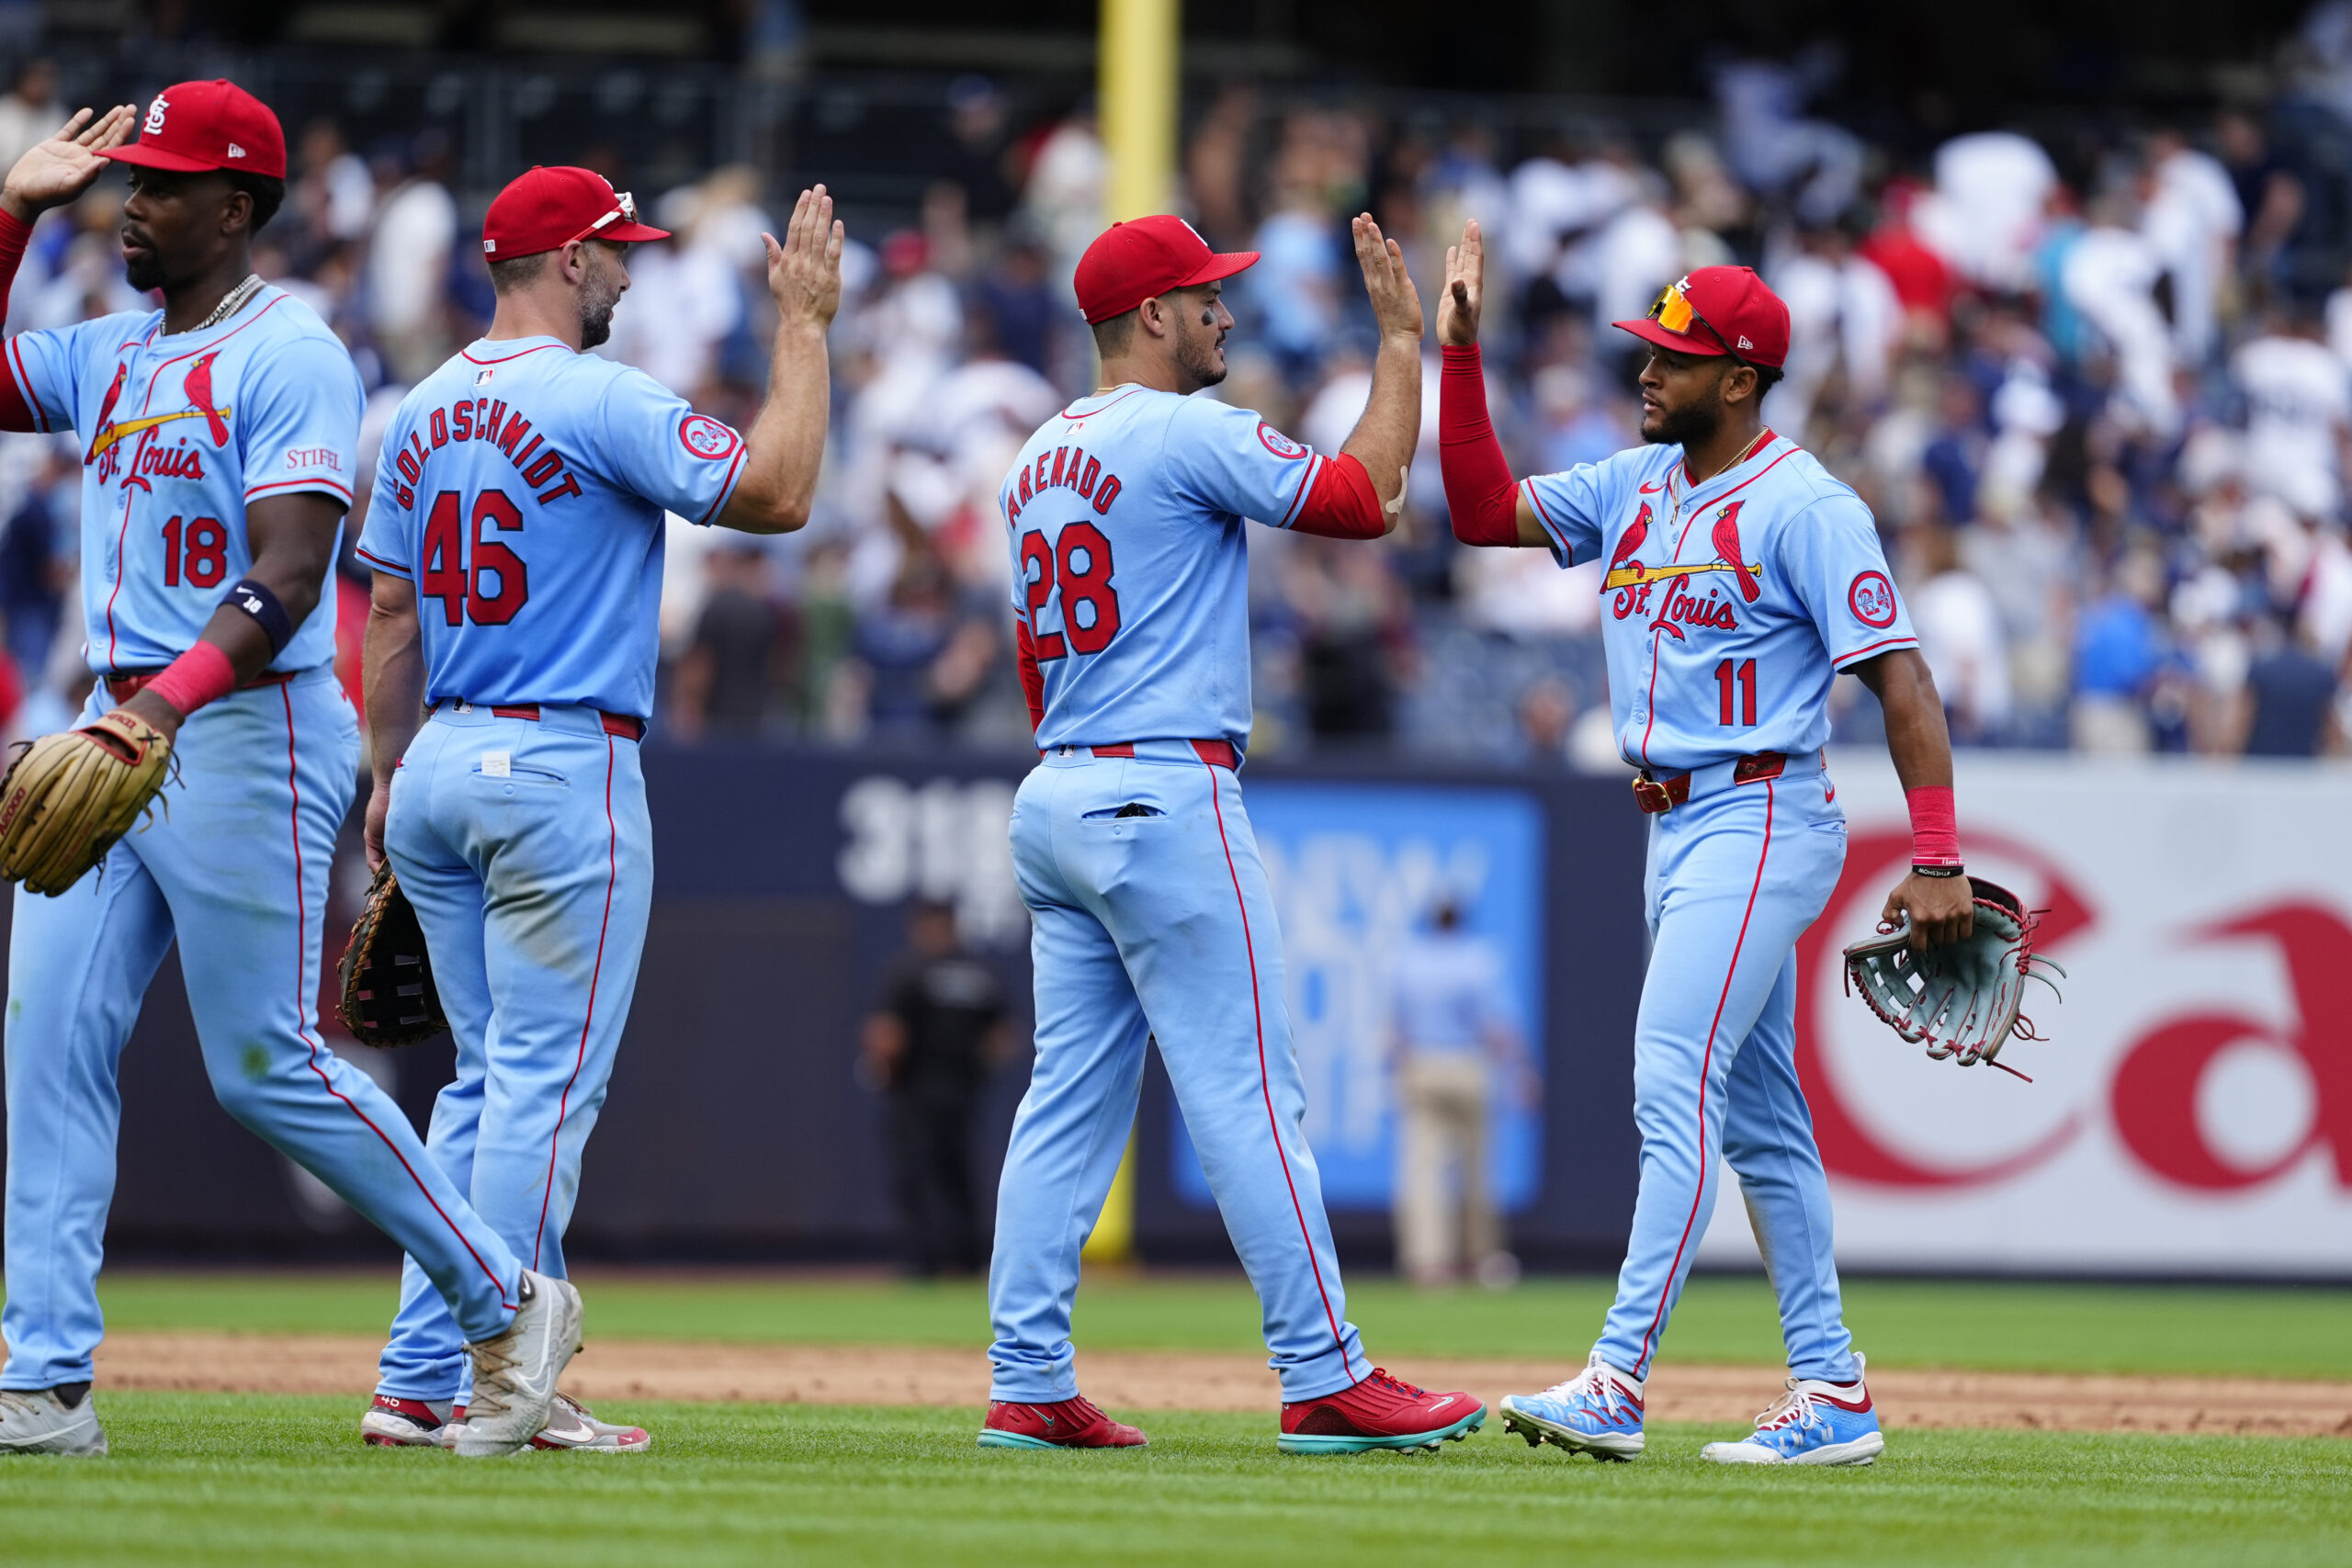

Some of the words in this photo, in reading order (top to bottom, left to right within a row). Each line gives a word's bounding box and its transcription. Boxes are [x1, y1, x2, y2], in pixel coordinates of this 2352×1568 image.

[99, 420, 120, 485] St.
[120, 424, 205, 494] Louis
[287, 448, 342, 472] STIFEL
[393, 398, 582, 511] GOLDSCHMIDT
[1007, 446, 1122, 530] ARENADO
[162, 515, 227, 588] 18
[423, 490, 528, 626] 46
[243, 596, 263, 614] 18
[1021, 520, 1122, 663] 28
[1613, 560, 1651, 620] St.
[1649, 573, 1739, 642] Louis
[1714, 658, 1757, 726] 11
